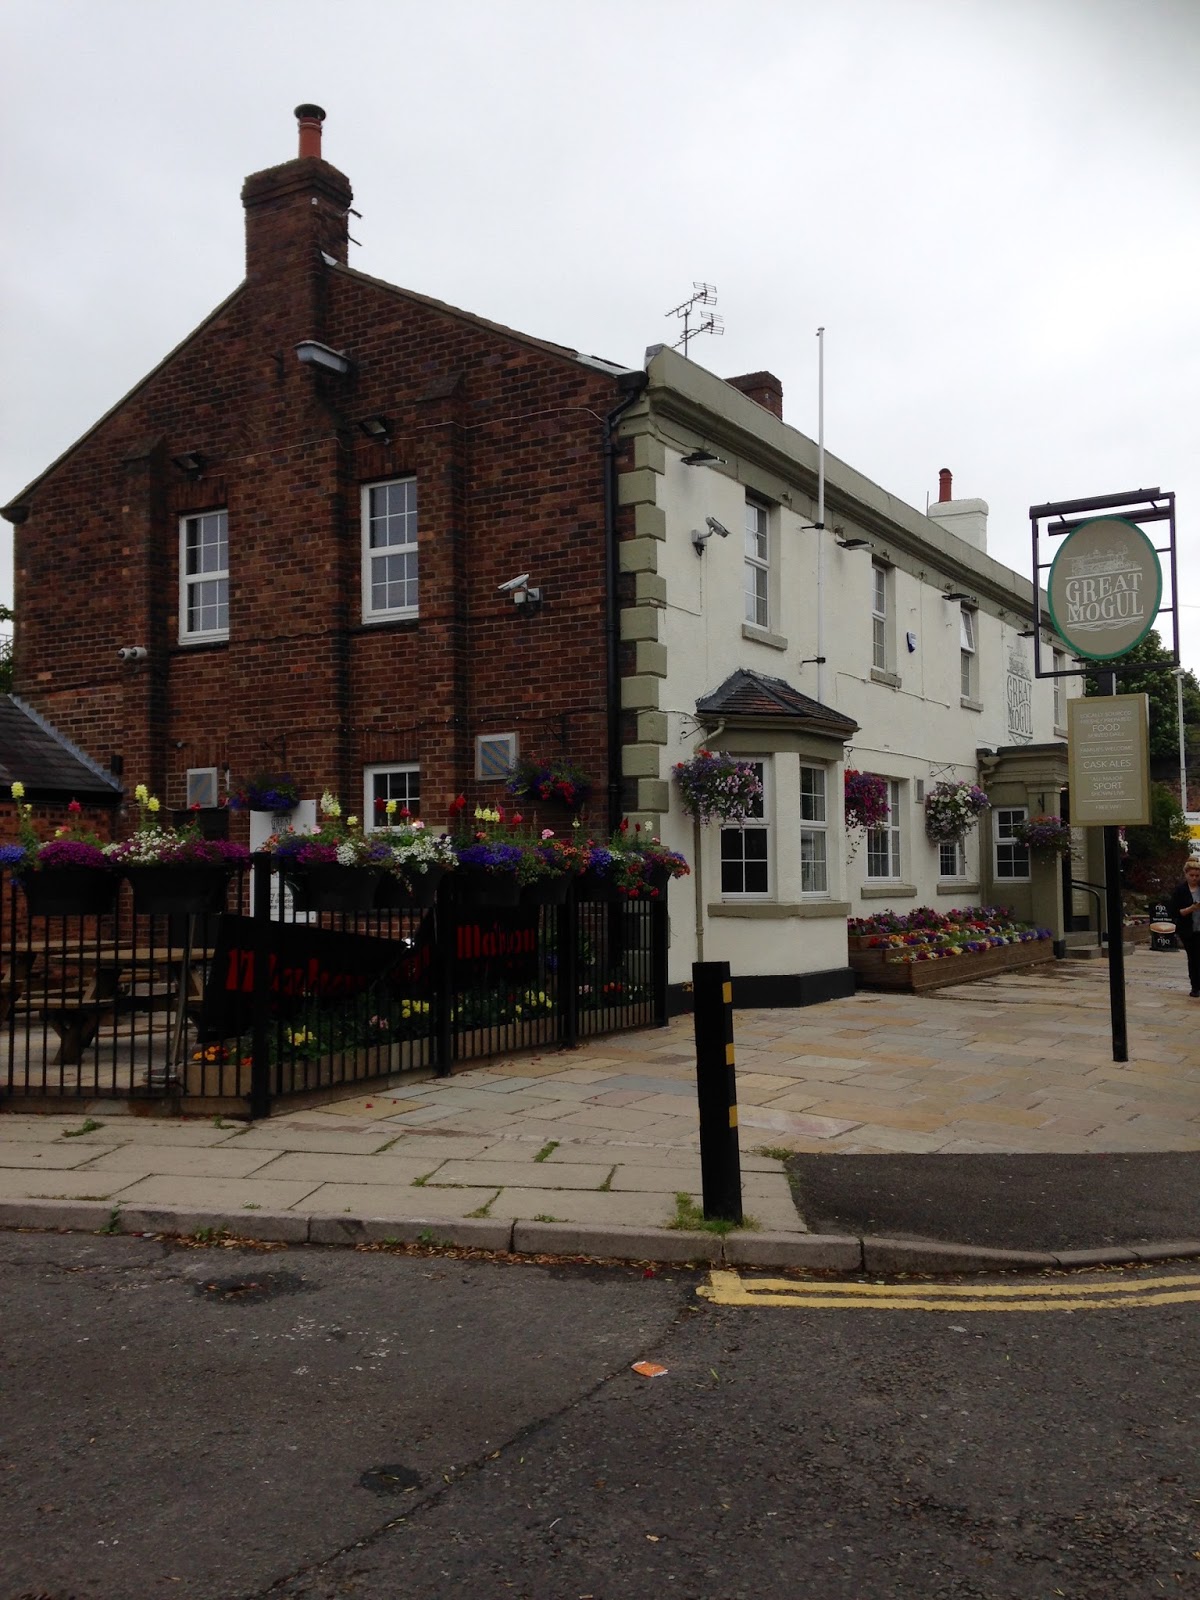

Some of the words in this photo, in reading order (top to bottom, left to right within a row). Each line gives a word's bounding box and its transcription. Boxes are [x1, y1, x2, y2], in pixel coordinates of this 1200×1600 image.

[1066, 573, 1142, 611] GREAT
[1066, 591, 1143, 622] MOGUL
[1007, 675, 1032, 708] GREAT
[1007, 701, 1033, 734] MOGUL
[1092, 723, 1121, 732] FOOD
[1083, 760, 1107, 769] CASK
[1109, 759, 1131, 768] ALES
[1093, 782, 1122, 790] SPORT
